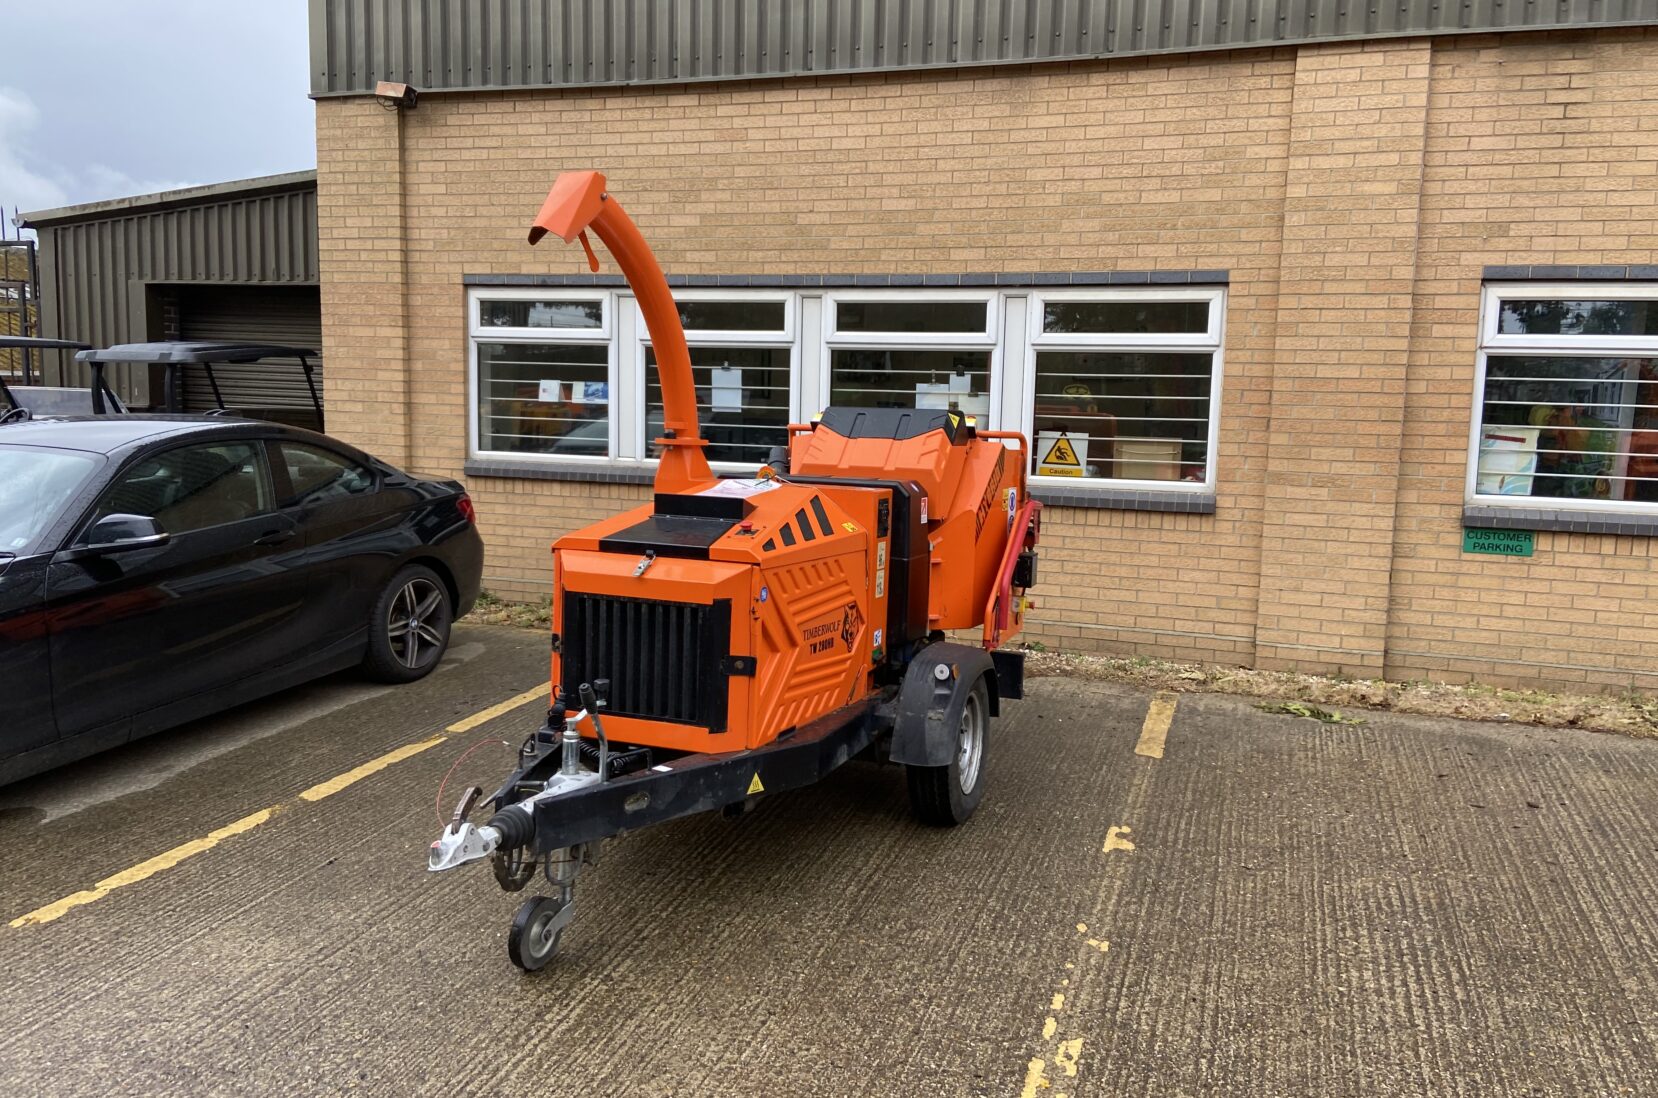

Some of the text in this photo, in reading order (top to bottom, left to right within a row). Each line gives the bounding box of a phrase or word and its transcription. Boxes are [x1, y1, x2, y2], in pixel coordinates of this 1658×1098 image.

[1466, 531, 1532, 542] CUSTOMER
[1473, 542, 1523, 553] PARKING
[803, 620, 841, 641] TIMBERWOLF
[810, 642, 818, 656] TW
